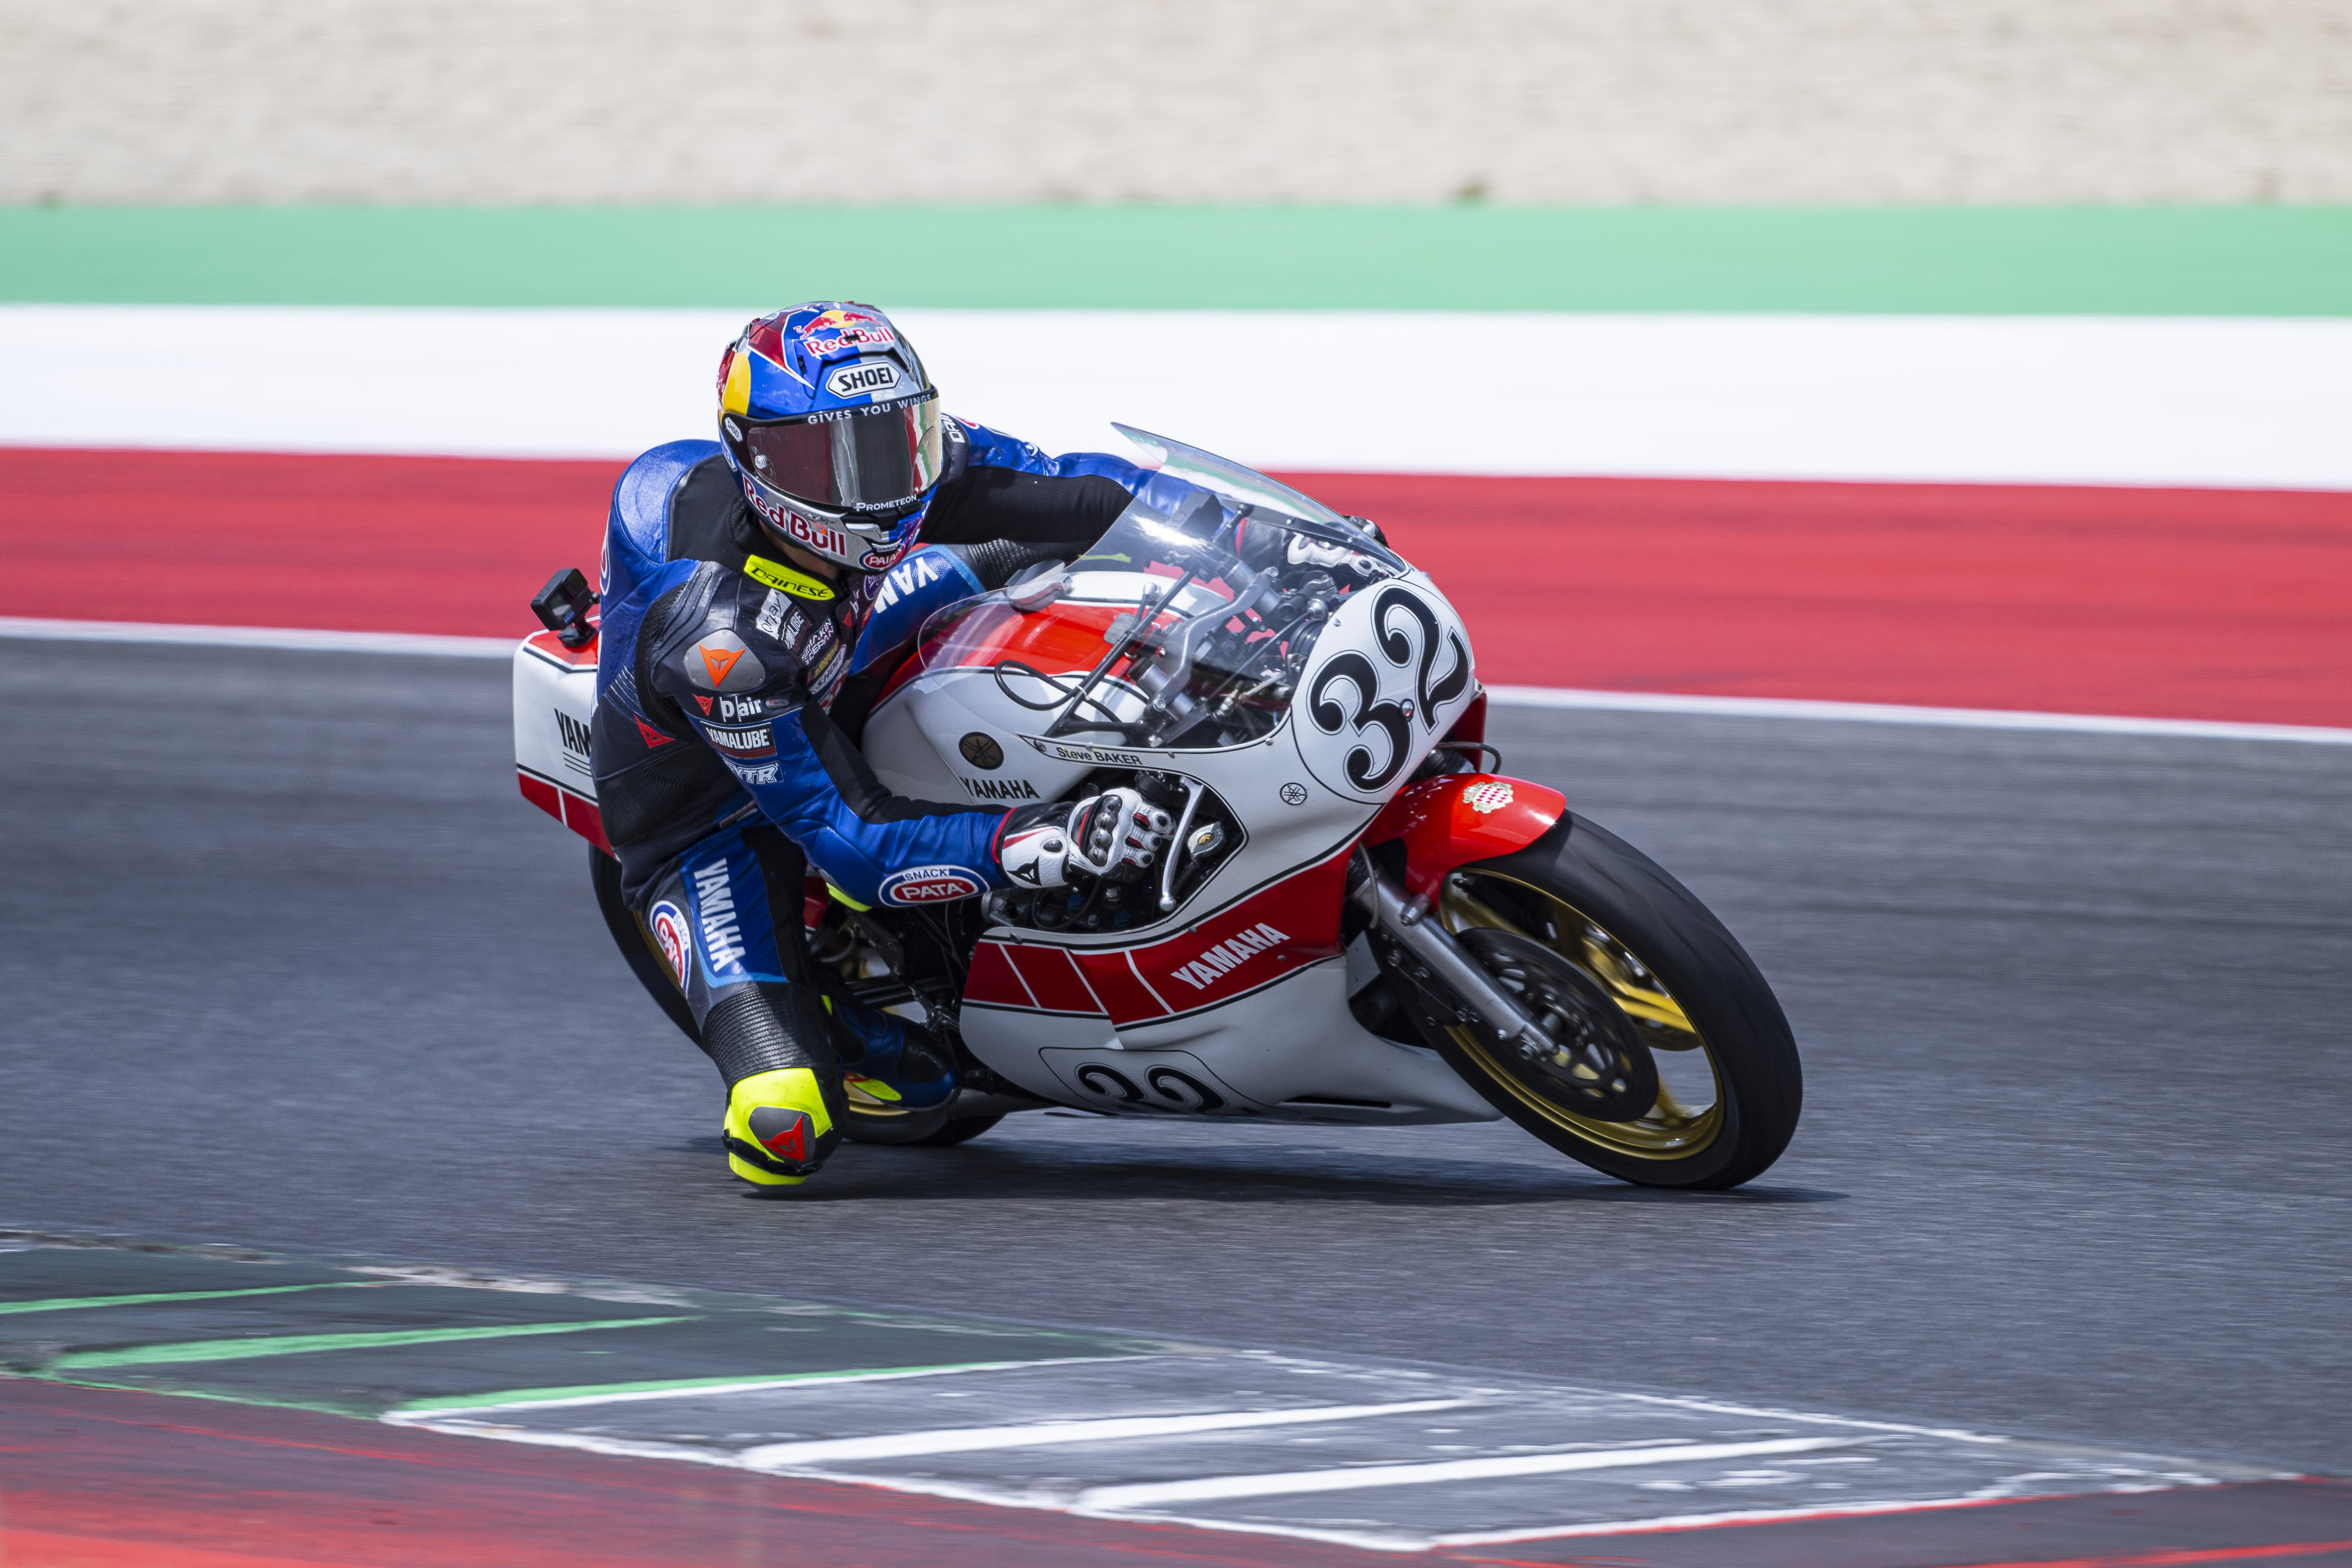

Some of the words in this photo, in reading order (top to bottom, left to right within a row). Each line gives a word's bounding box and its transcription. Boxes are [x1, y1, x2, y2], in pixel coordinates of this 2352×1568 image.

[806, 330, 853, 354] Red
[853, 327, 894, 343] Bull
[838, 367, 893, 392] SHOEI
[860, 403, 891, 417] YOU
[727, 420, 740, 439] SHOEI
[854, 494, 917, 511] PROMETEON
[743, 476, 786, 529] Red
[790, 511, 846, 556] Bull
[751, 567, 829, 598] DAINESE
[1308, 586, 1471, 791] 32
[706, 727, 770, 749] YAMALUBE
[1058, 747, 1092, 761] Steve
[1094, 751, 1142, 765] BAKER
[959, 776, 1040, 800] YAMAHA
[904, 868, 948, 881] SNACK
[901, 882, 967, 900] PATA
[694, 857, 746, 972] YAMAHA
[1171, 922, 1290, 990] YAMAHA
